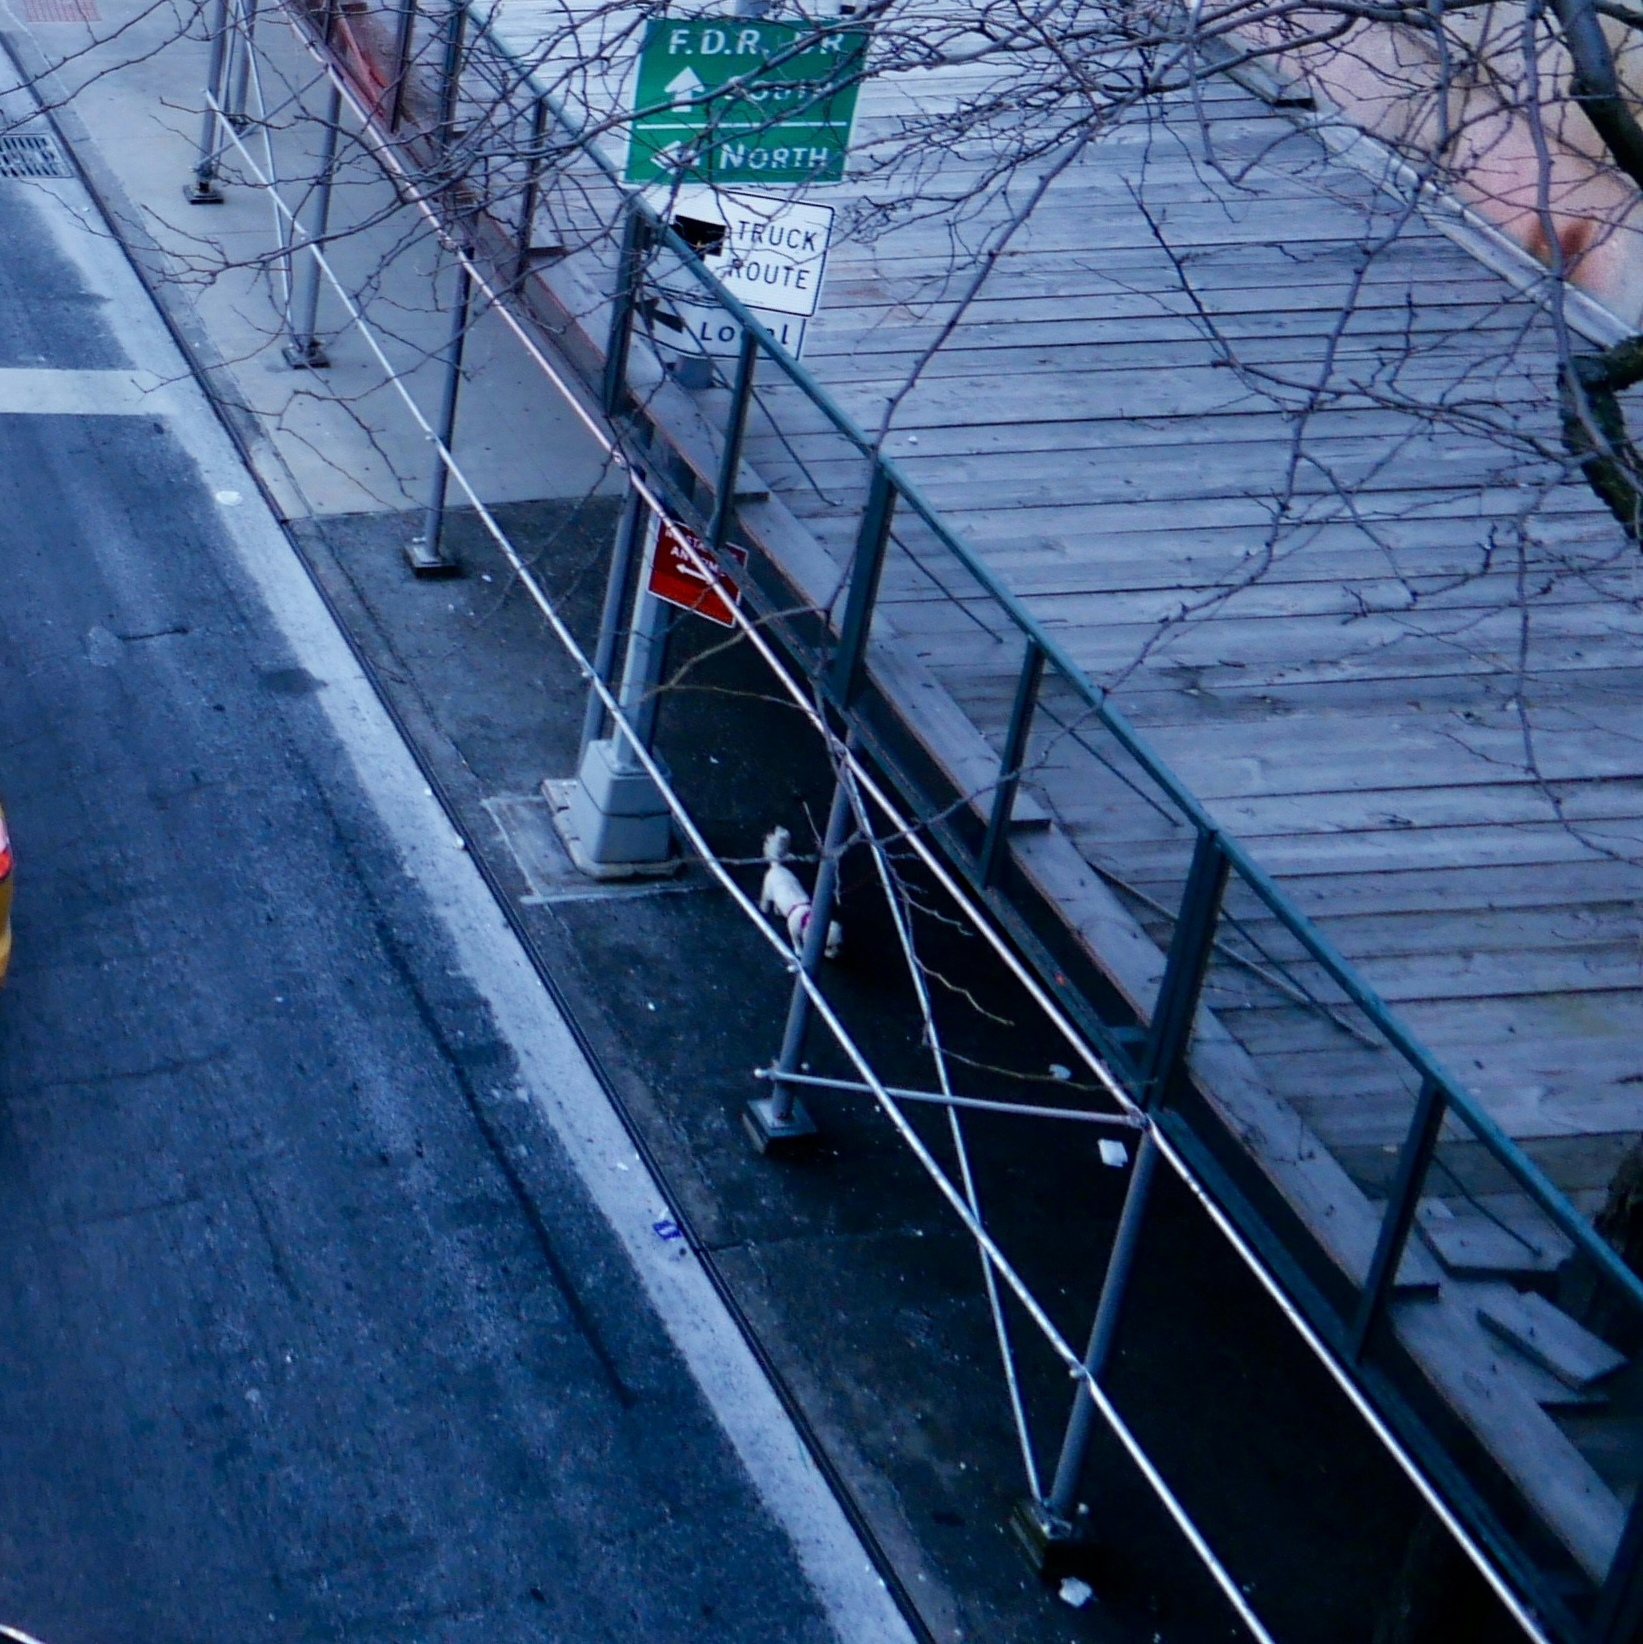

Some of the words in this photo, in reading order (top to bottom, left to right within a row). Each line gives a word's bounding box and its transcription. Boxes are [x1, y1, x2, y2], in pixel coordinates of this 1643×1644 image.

[668, 28, 770, 55] F.D.R.
[719, 143, 829, 170] NORTH
[738, 220, 818, 252] TRUCK
[731, 258, 811, 290] ROUTE
[700, 320, 790, 345] Lol
